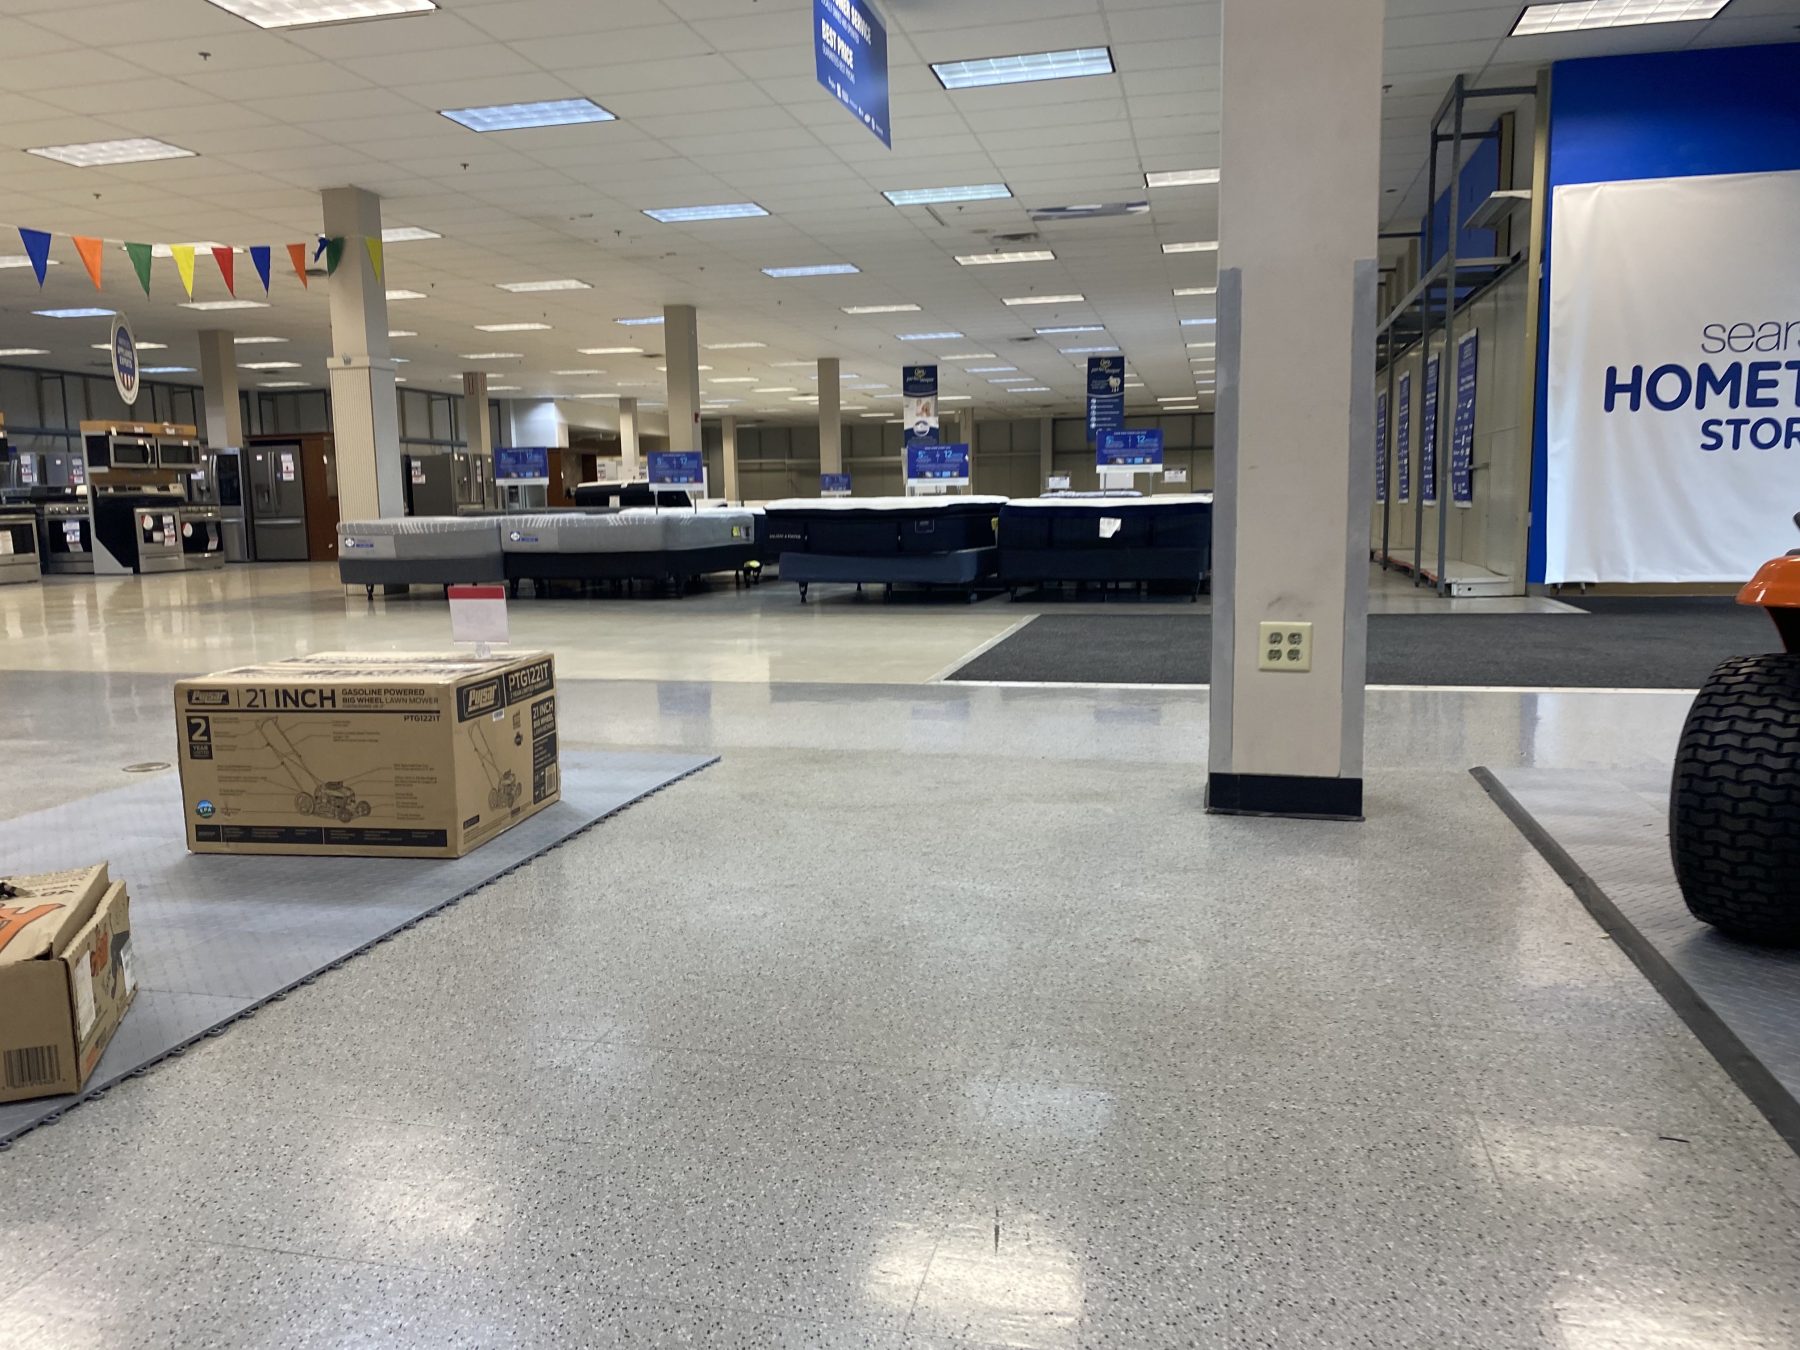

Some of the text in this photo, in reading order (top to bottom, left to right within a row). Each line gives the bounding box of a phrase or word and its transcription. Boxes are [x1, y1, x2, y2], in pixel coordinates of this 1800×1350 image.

[821, 18, 837, 51] BEST
[837, 35, 854, 70] PRICE
[1701, 321, 1800, 354] sear
[508, 662, 549, 691] PTG1221T
[246, 689, 267, 708] 21
[275, 688, 336, 708] INCH
[341, 688, 425, 696] GASOLINE POWERED
[403, 714, 440, 722] PTG1221T
[533, 701, 554, 718] 21 INCH
[190, 718, 208, 741] 2
